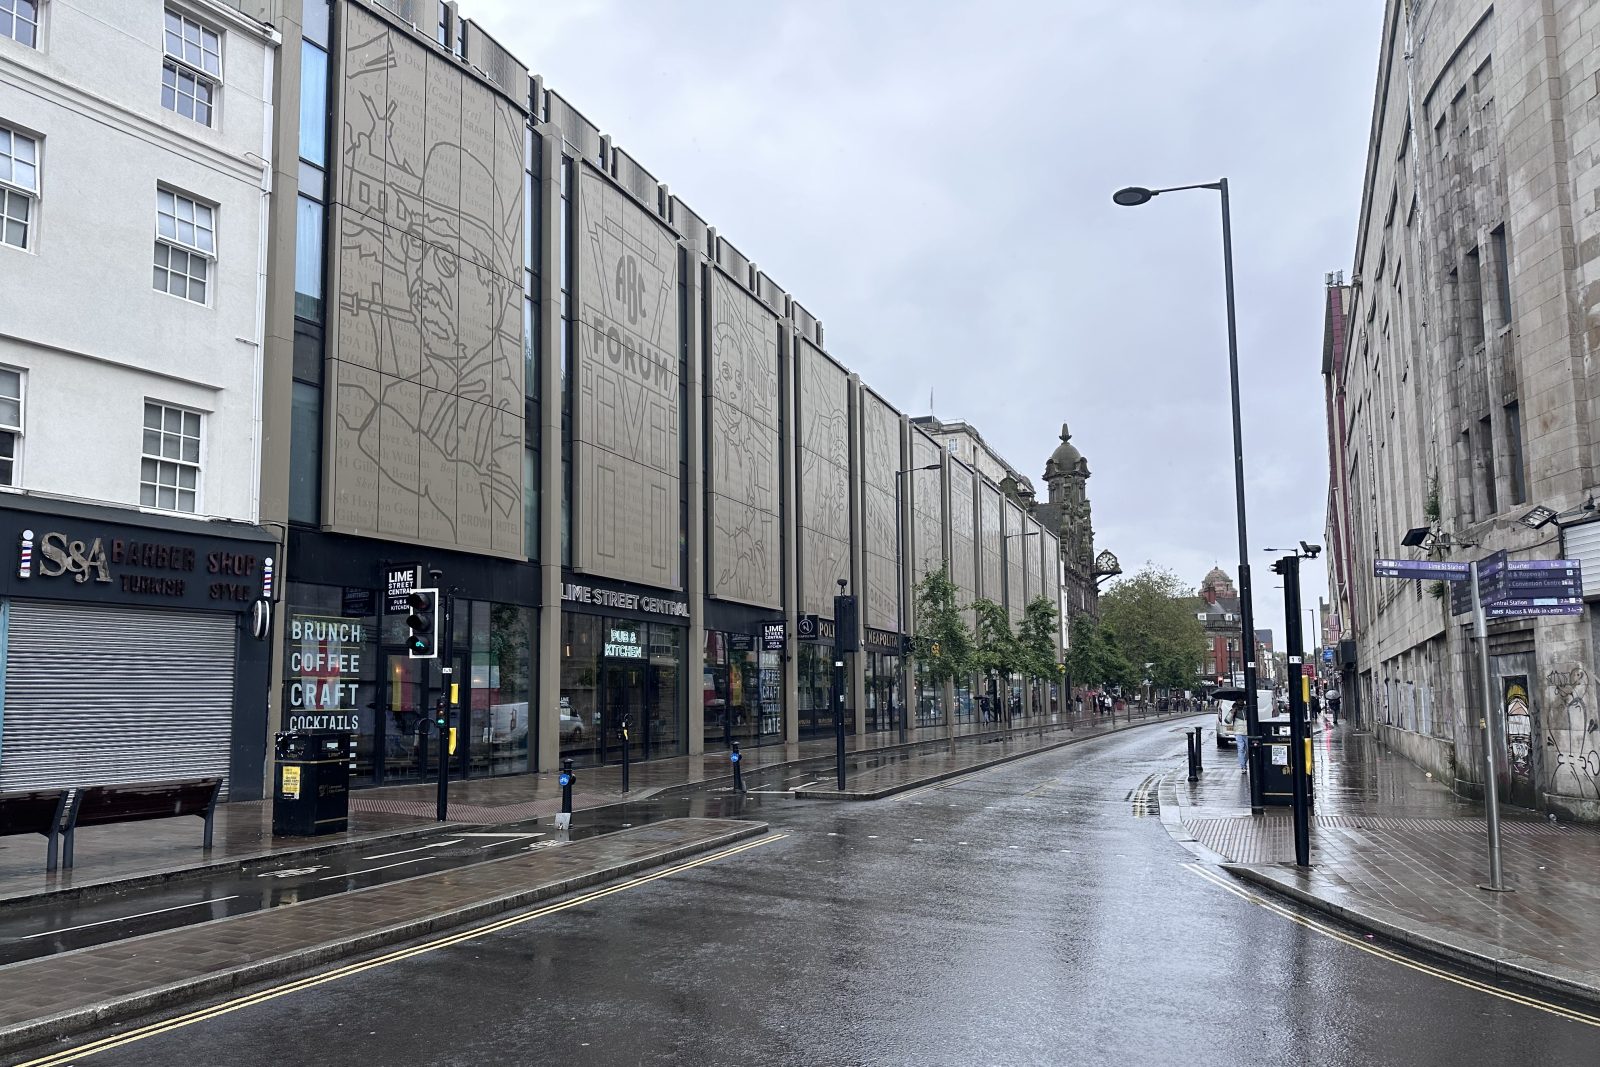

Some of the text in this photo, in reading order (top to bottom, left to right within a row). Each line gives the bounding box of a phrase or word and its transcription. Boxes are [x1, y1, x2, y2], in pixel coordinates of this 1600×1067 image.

[615, 254, 647, 325] ABC
[593, 316, 668, 391] FORUM
[39, 531, 113, 583] S&A
[207, 551, 257, 576] SHOP
[388, 570, 414, 583] LIME
[388, 581, 414, 589] STREET
[209, 583, 251, 602] STYLE
[560, 582, 690, 617] LIME STREET CENTRAL
[292, 621, 361, 643] BRUNCH
[610, 628, 637, 644] PUB &
[764, 625, 784, 633] LIME
[868, 630, 898, 647] NEAPOLITA
[604, 643, 642, 658] KITCHEN
[291, 652, 360, 673] COFFEE
[291, 683, 359, 706] CRAFT
[762, 686, 780, 699] CRAFT
[290, 715, 359, 730] COCKTAILS
[763, 717, 781, 734] LATE
